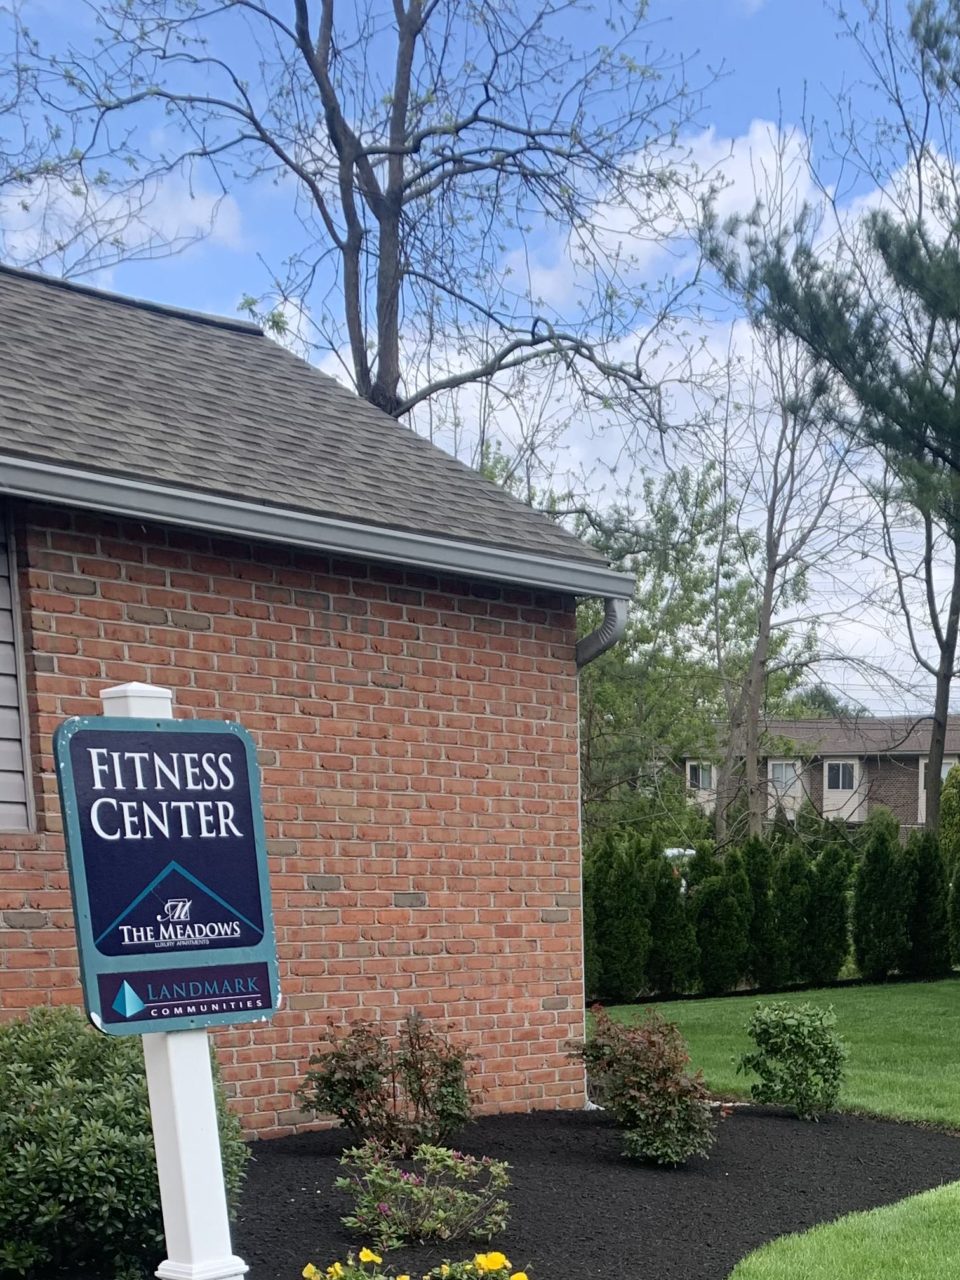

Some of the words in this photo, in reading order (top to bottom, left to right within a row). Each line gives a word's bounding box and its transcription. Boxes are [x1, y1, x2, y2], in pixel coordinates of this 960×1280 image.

[86, 748, 235, 790] FITNESS
[90, 797, 244, 840] CENTER
[119, 925, 155, 943] THE
[160, 921, 240, 940] MEADOWS
[147, 977, 260, 1000] LANDMARK
[151, 1000, 262, 1016] COMMUNITIES
